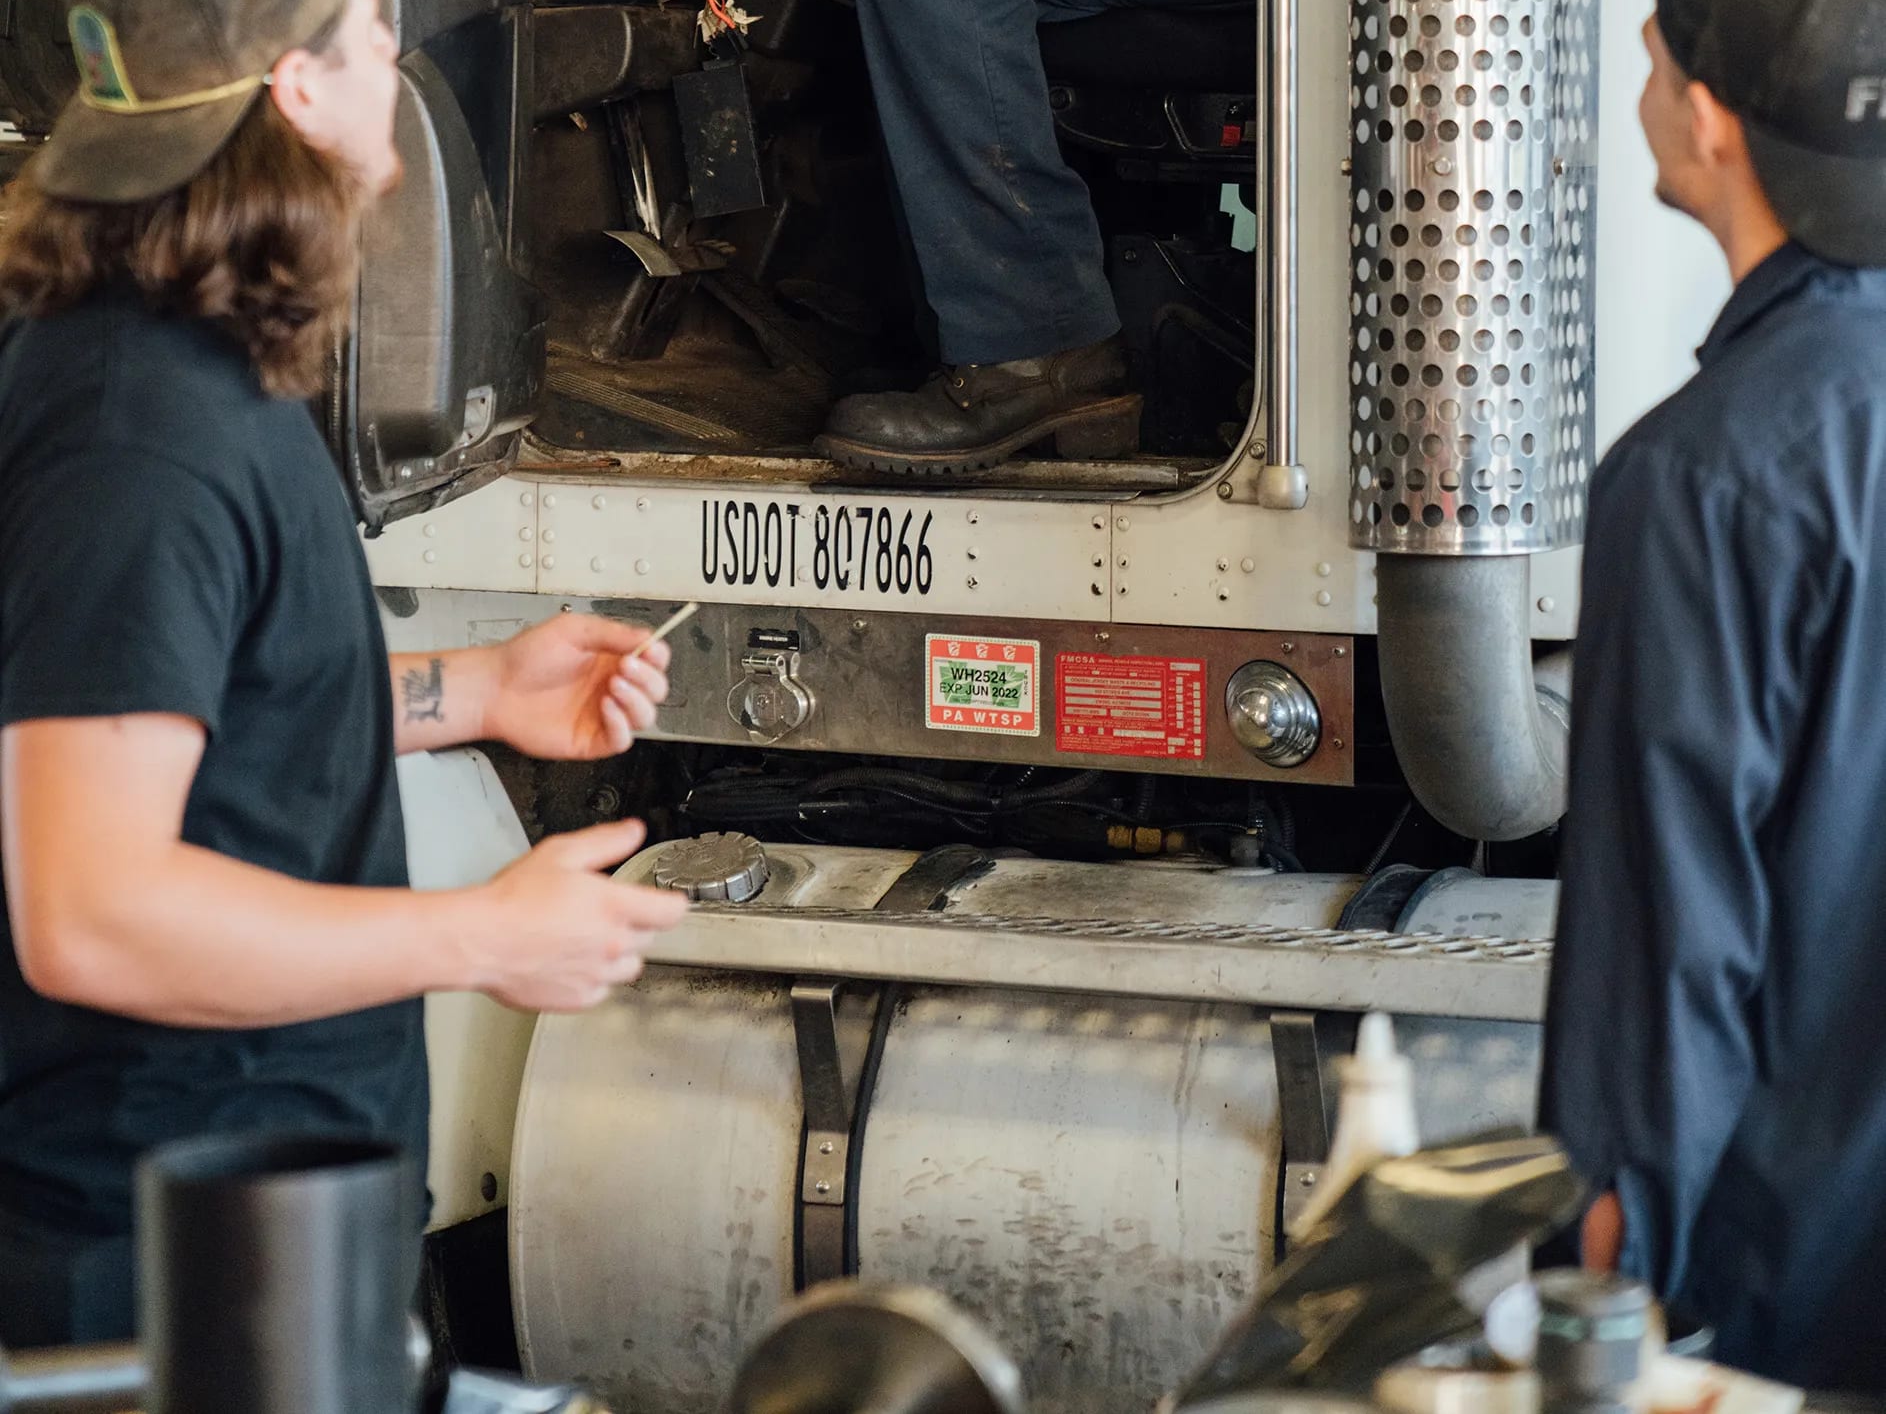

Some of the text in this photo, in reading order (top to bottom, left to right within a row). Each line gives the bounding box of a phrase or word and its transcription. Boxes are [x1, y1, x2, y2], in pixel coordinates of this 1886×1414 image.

[702, 500, 933, 595] USDOT 807866
[1060, 655, 1095, 664] FMCSA
[951, 667, 1007, 684] WH2524
[940, 682, 1019, 699] EXP JUN 2022
[943, 709, 1023, 726] PA WTSP
